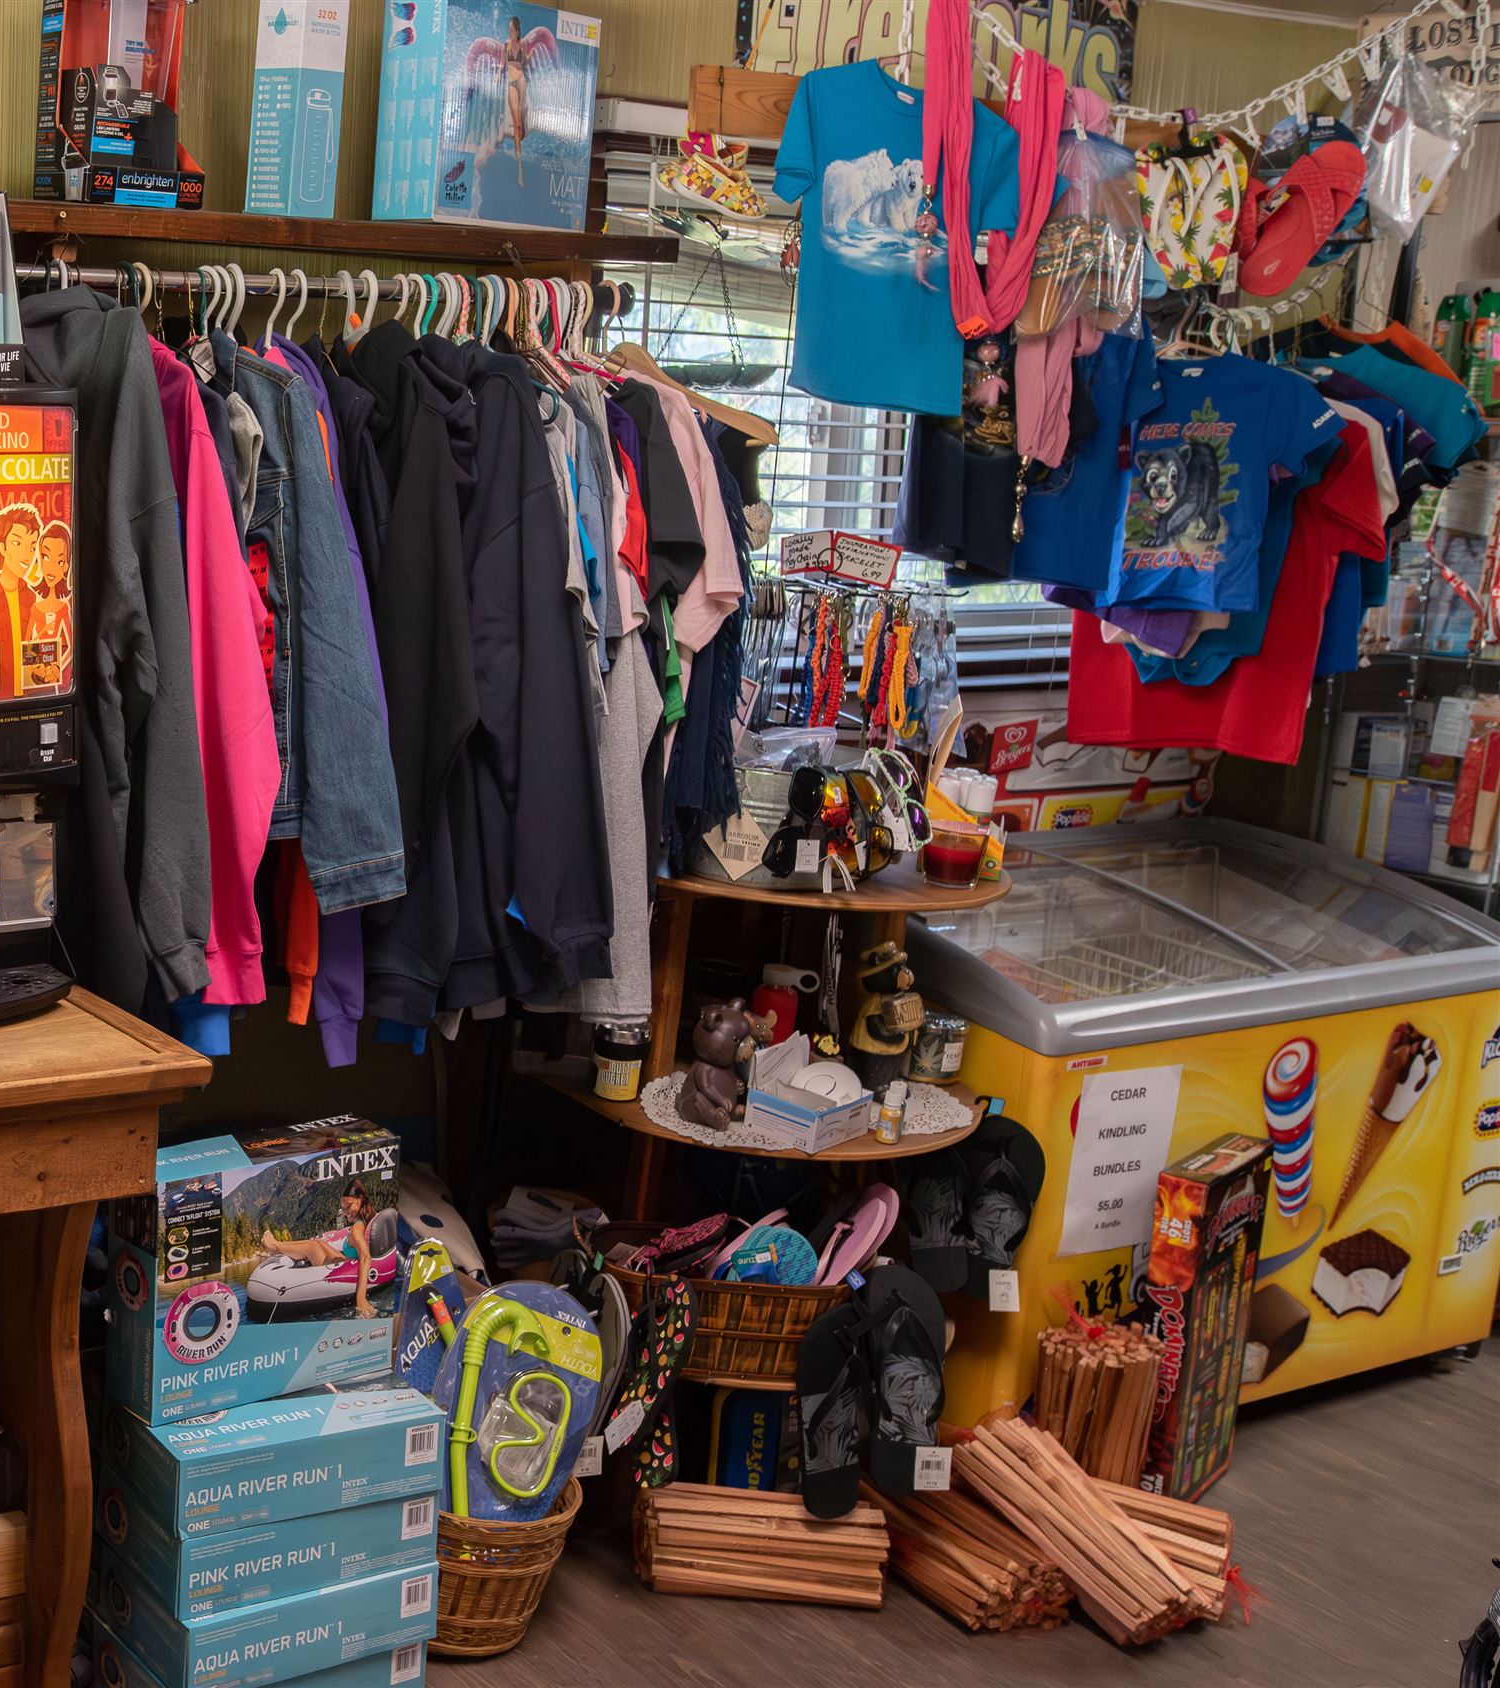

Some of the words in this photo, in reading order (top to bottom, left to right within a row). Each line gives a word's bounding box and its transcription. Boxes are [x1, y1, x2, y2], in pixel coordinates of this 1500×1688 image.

[317, 10, 326, 19] 32
[328, 11, 338, 20] OZ
[94, 174, 114, 188] 274
[121, 172, 175, 190] enbrighten
[179, 181, 202, 194] 1000
[445, 182, 468, 195] Colette
[549, 175, 584, 200] MAT
[445, 190, 466, 203] Miller
[6, 350, 19, 362] LIFE
[0, 361, 11, 373] VIE
[1139, 423, 1181, 441] HERE
[1181, 420, 1237, 438] COMES
[784, 533, 814, 549] Locally
[789, 543, 810, 558] made
[836, 550, 887, 569] BRACELET
[861, 567, 883, 580] 6.99
[40, 643, 56, 654] Spice
[42, 653, 55, 663] Chai
[43, 755, 53, 763] Chai
[992, 742, 1033, 767] Breyers
[1110, 1087, 1147, 1101] CEDAR
[287, 1113, 358, 1135] INTEX
[1098, 1123, 1147, 1140] KINDLING
[316, 1145, 397, 1183] INTEX
[1092, 1159, 1142, 1177] BUNDLES
[1097, 1198, 1124, 1212] $5.00
[167, 1214, 186, 1225] CONNECT
[189, 1210, 204, 1221] FLOAT
[204, 1208, 221, 1218] SYSTEM
[1094, 1222, 1100, 1230] A
[1100, 1219, 1121, 1229] Bundle
[1167, 1217, 1183, 1239] 46
[1182, 1218, 1193, 1244] SHOTS
[555, 1310, 587, 1329] INTEX
[175, 1345, 205, 1361] RIVER
[204, 1334, 227, 1358] RUN
[399, 1313, 436, 1373] AQUA
[160, 1373, 199, 1393] PINK
[203, 1360, 249, 1383] RIVER
[252, 1351, 285, 1371] RUN
[293, 1346, 299, 1361] 1
[560, 1352, 598, 1377] YOUTH
[161, 1405, 185, 1418] ONE
[167, 1427, 218, 1445] AQUA
[220, 1415, 271, 1434] RIVER
[271, 1409, 312, 1425] RUN
[316, 1406, 326, 1416] 1
[183, 1447, 207, 1456] ONE
[184, 1485, 234, 1509] AQUA
[237, 1474, 288, 1498] RIVER
[292, 1466, 329, 1488] RUN
[336, 1463, 342, 1479] 1
[341, 1477, 368, 1489] INTEX
[1138, 1470, 1153, 1494] 10
[184, 1503, 221, 1518] LOUNGE
[186, 1519, 211, 1533] ONE
[188, 1566, 229, 1590] PINK
[233, 1554, 283, 1578] RIVER
[286, 1546, 323, 1568] RUN
[329, 1541, 336, 1557] 1
[340, 1552, 368, 1564] INTEX
[188, 1584, 223, 1598] LOUNGE
[190, 1600, 214, 1614] ONE
[341, 1633, 367, 1645] INTEX
[193, 1650, 240, 1676] AQUA
[243, 1637, 291, 1661] RIVER
[295, 1627, 330, 1648] RUN
[337, 1620, 343, 1635] 1
